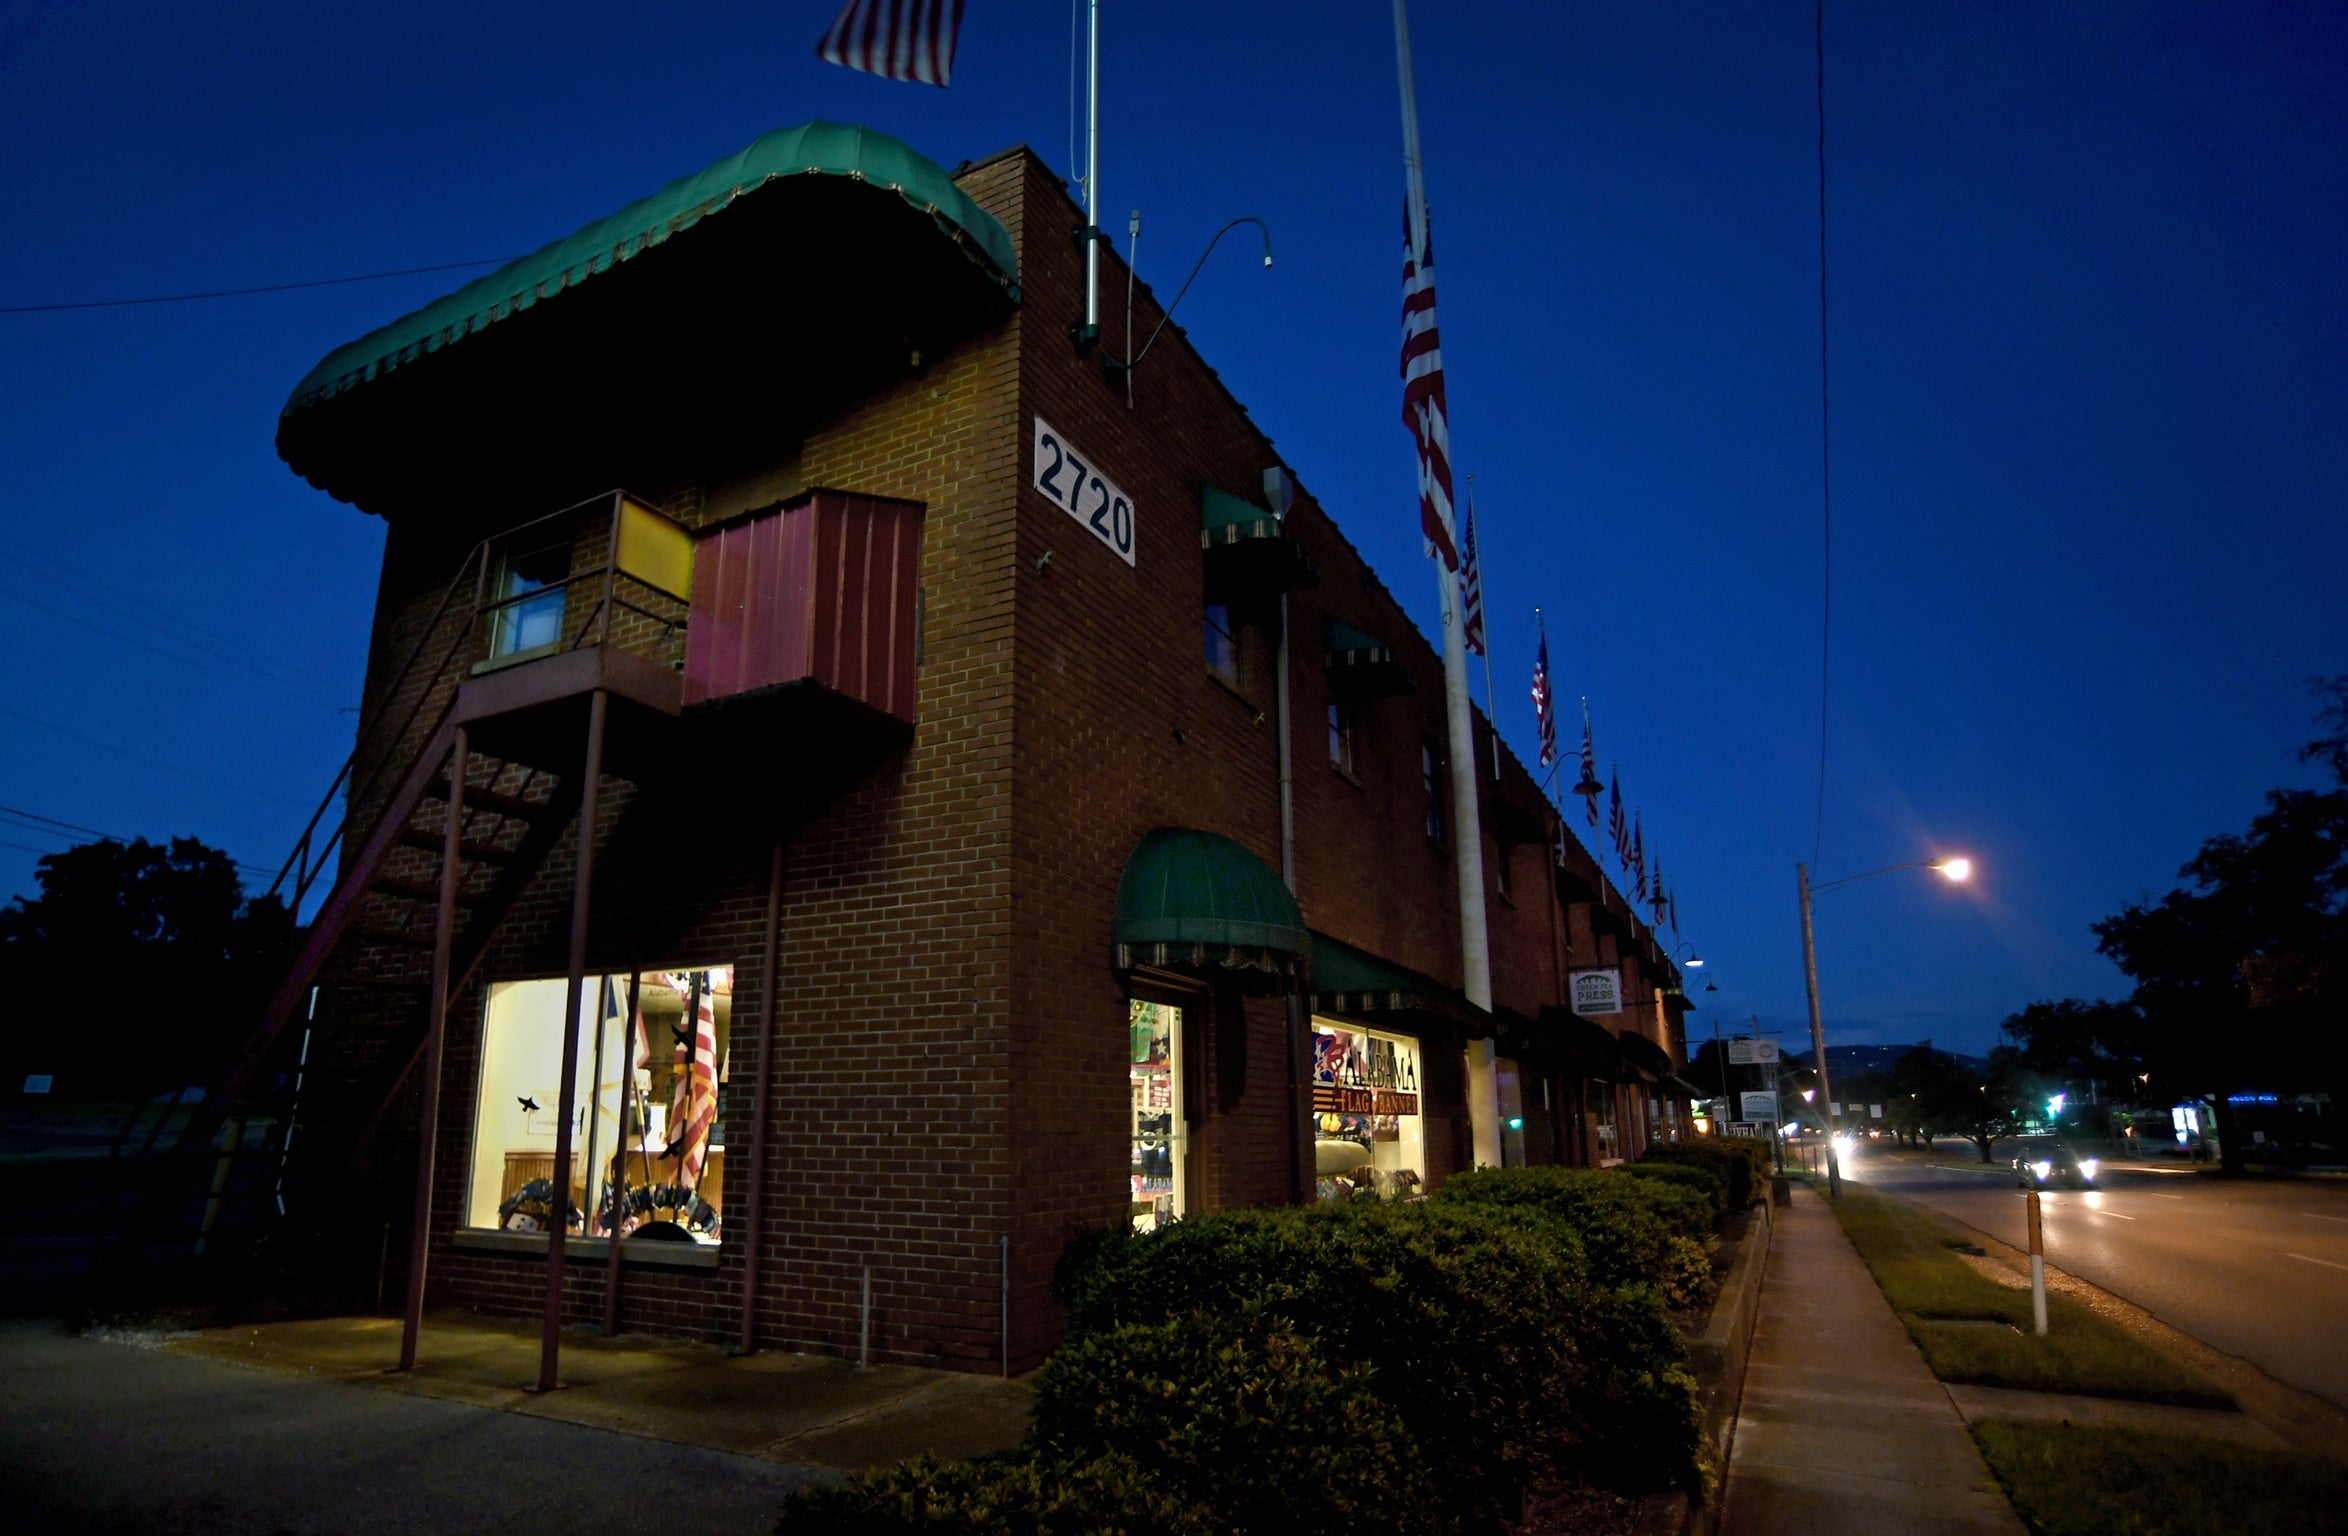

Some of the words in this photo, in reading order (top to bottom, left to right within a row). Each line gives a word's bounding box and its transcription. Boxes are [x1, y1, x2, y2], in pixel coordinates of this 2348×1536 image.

[1039, 433, 1132, 554] 2720
[1577, 989, 1614, 1002] PRESS
[1344, 1037, 1417, 1091] ALABAMA
[1337, 1090, 1369, 1112] FLAG
